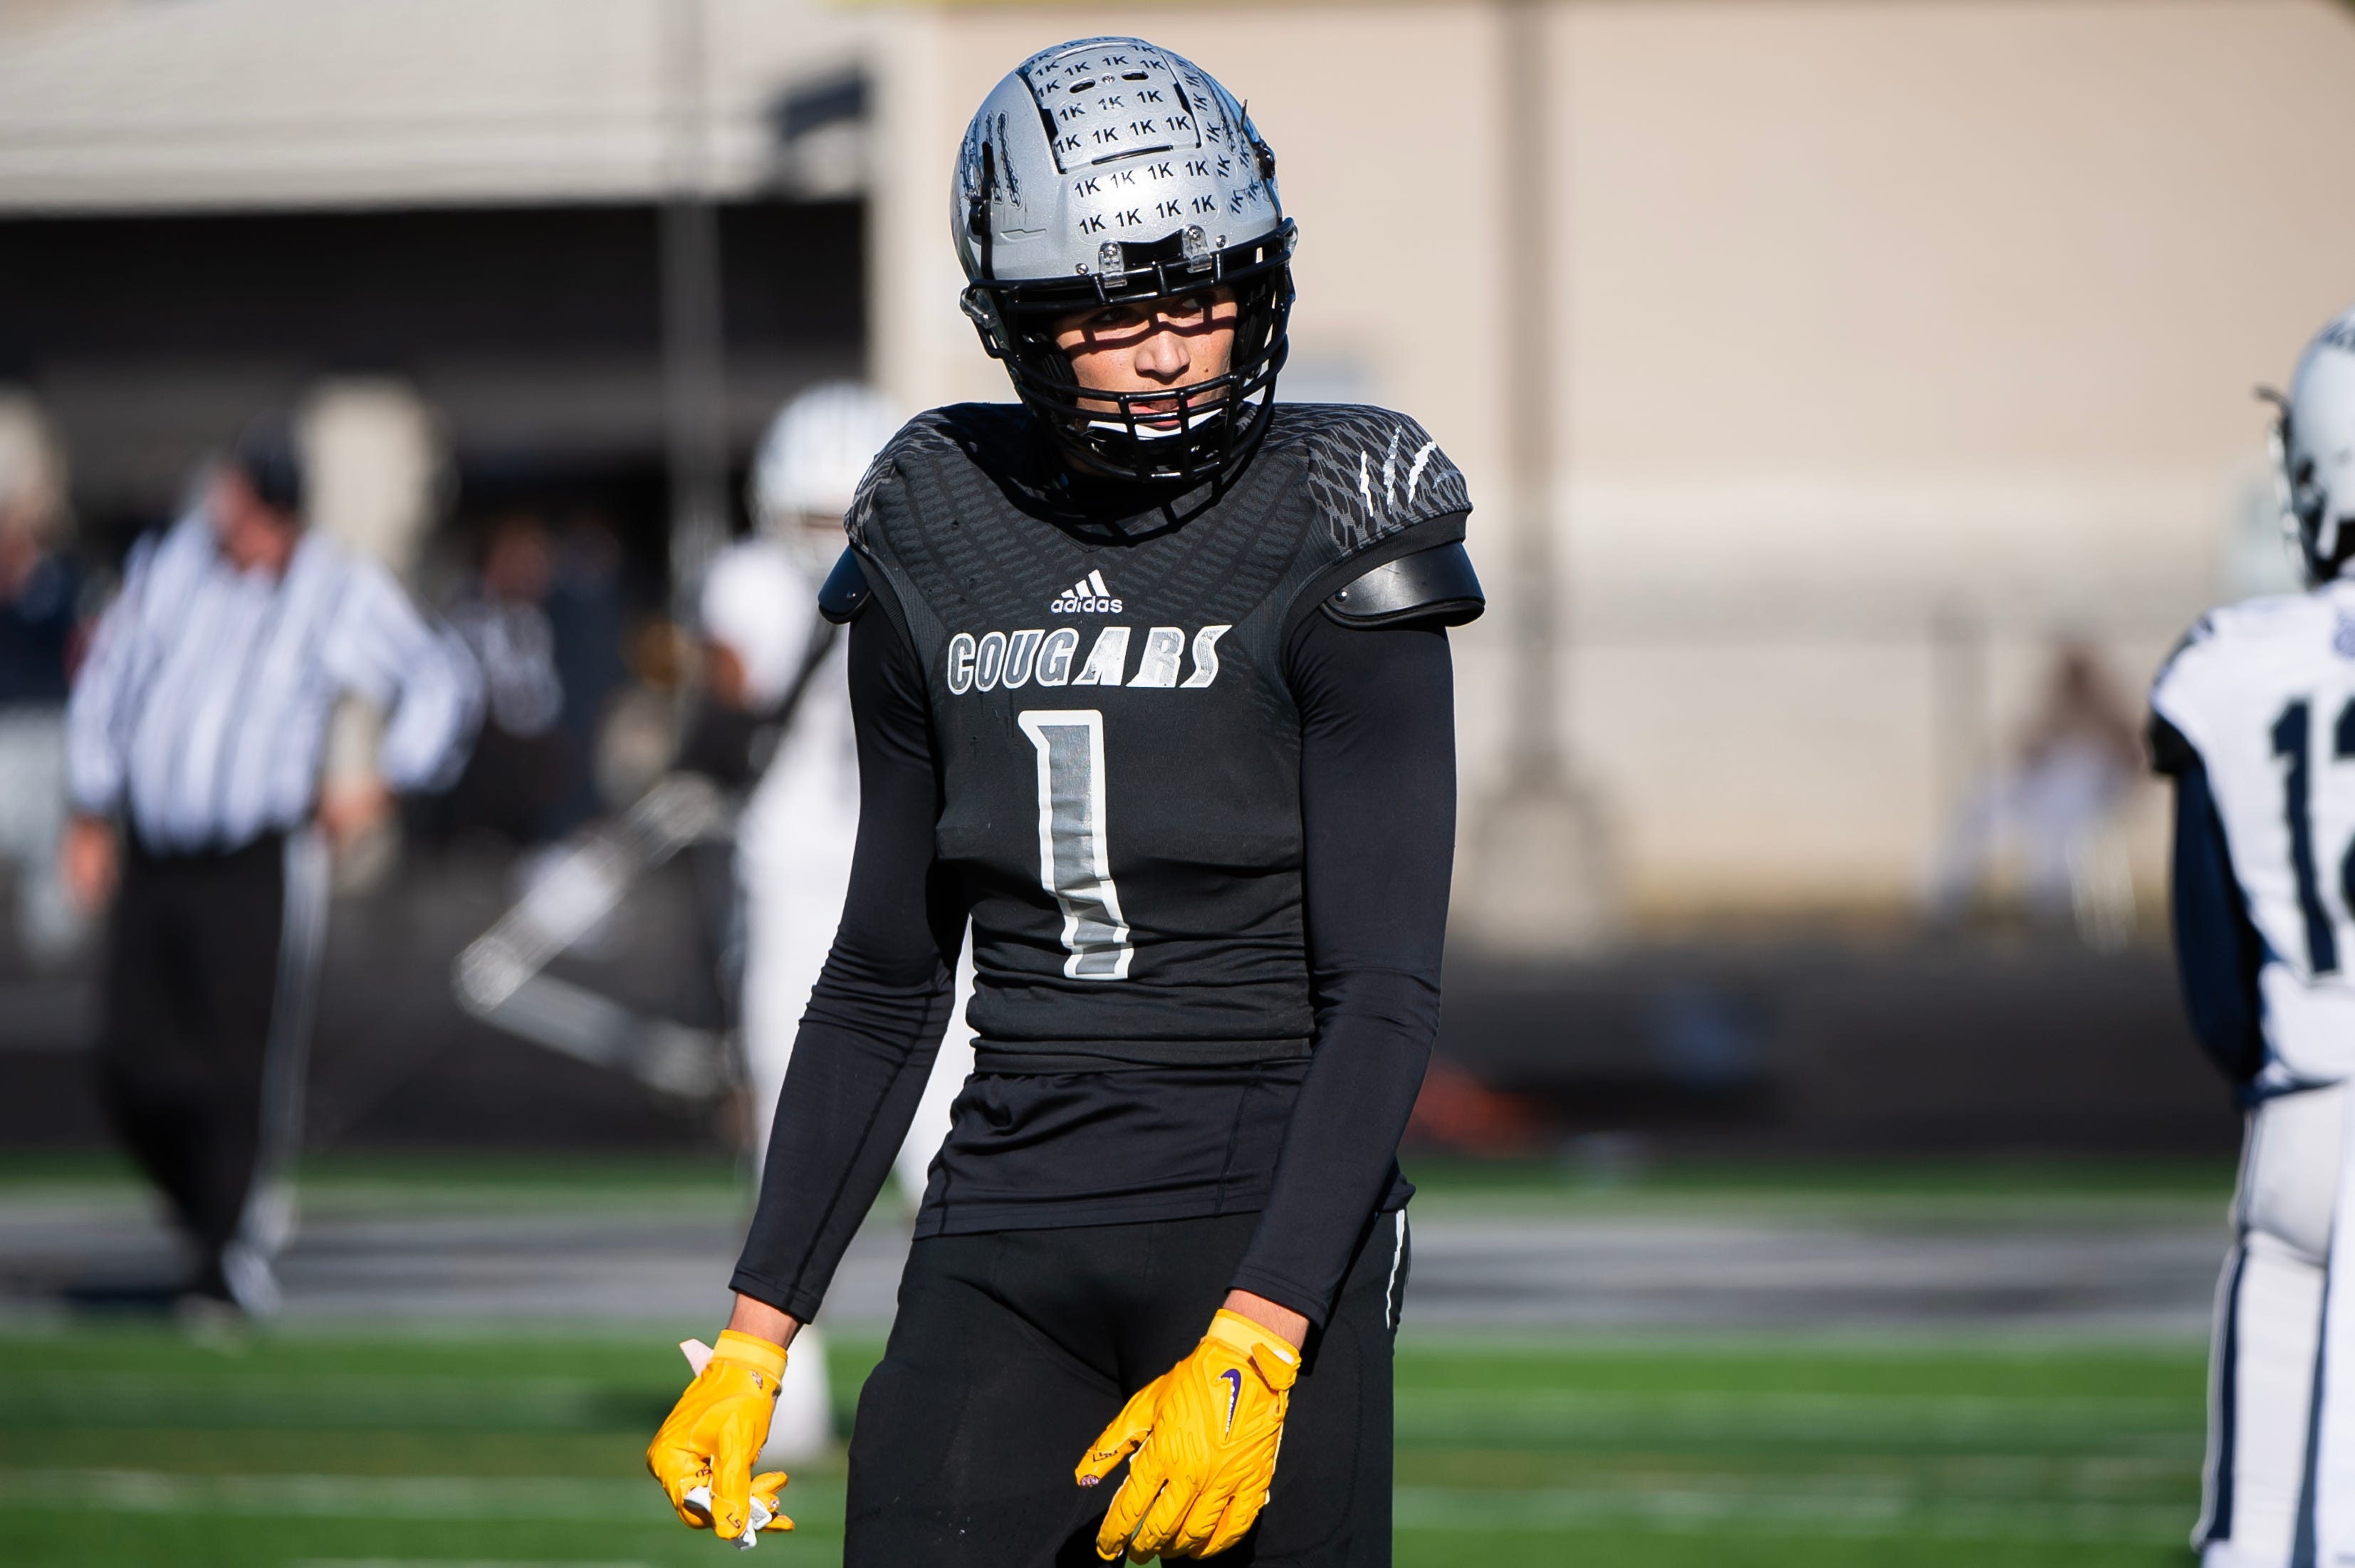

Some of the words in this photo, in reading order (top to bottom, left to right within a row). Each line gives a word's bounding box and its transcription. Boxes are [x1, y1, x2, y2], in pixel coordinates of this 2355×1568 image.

[1035, 61, 1060, 76] 1K
[1065, 62, 1091, 76] 1K
[1102, 56, 1129, 66] 1K
[1140, 60, 1166, 70] 1K
[1037, 79, 1060, 97] 1K
[1060, 103, 1085, 121] 1K
[1098, 95, 1124, 110] 1K
[1137, 90, 1163, 103] 1K
[1193, 93, 1208, 112] 1K
[1055, 134, 1081, 153] 1K
[1092, 127, 1119, 144] 1K
[1130, 119, 1156, 136] 1K
[1166, 116, 1191, 130] 1K
[1206, 121, 1221, 143] 1K
[1075, 177, 1101, 197] 1K
[1110, 170, 1135, 188] 1K
[1147, 162, 1174, 179] 1K
[1185, 160, 1209, 176] 1K
[1217, 154, 1231, 178] 1K
[1080, 214, 1106, 234] 1K
[1115, 209, 1142, 226] 1K
[1156, 199, 1182, 219] 1K
[1191, 194, 1216, 214] 1K
[1230, 189, 1243, 214] 1K
[1050, 595, 1123, 613] adidas
[947, 624, 1233, 696] COUGARS
[1018, 709, 1134, 980] 1
